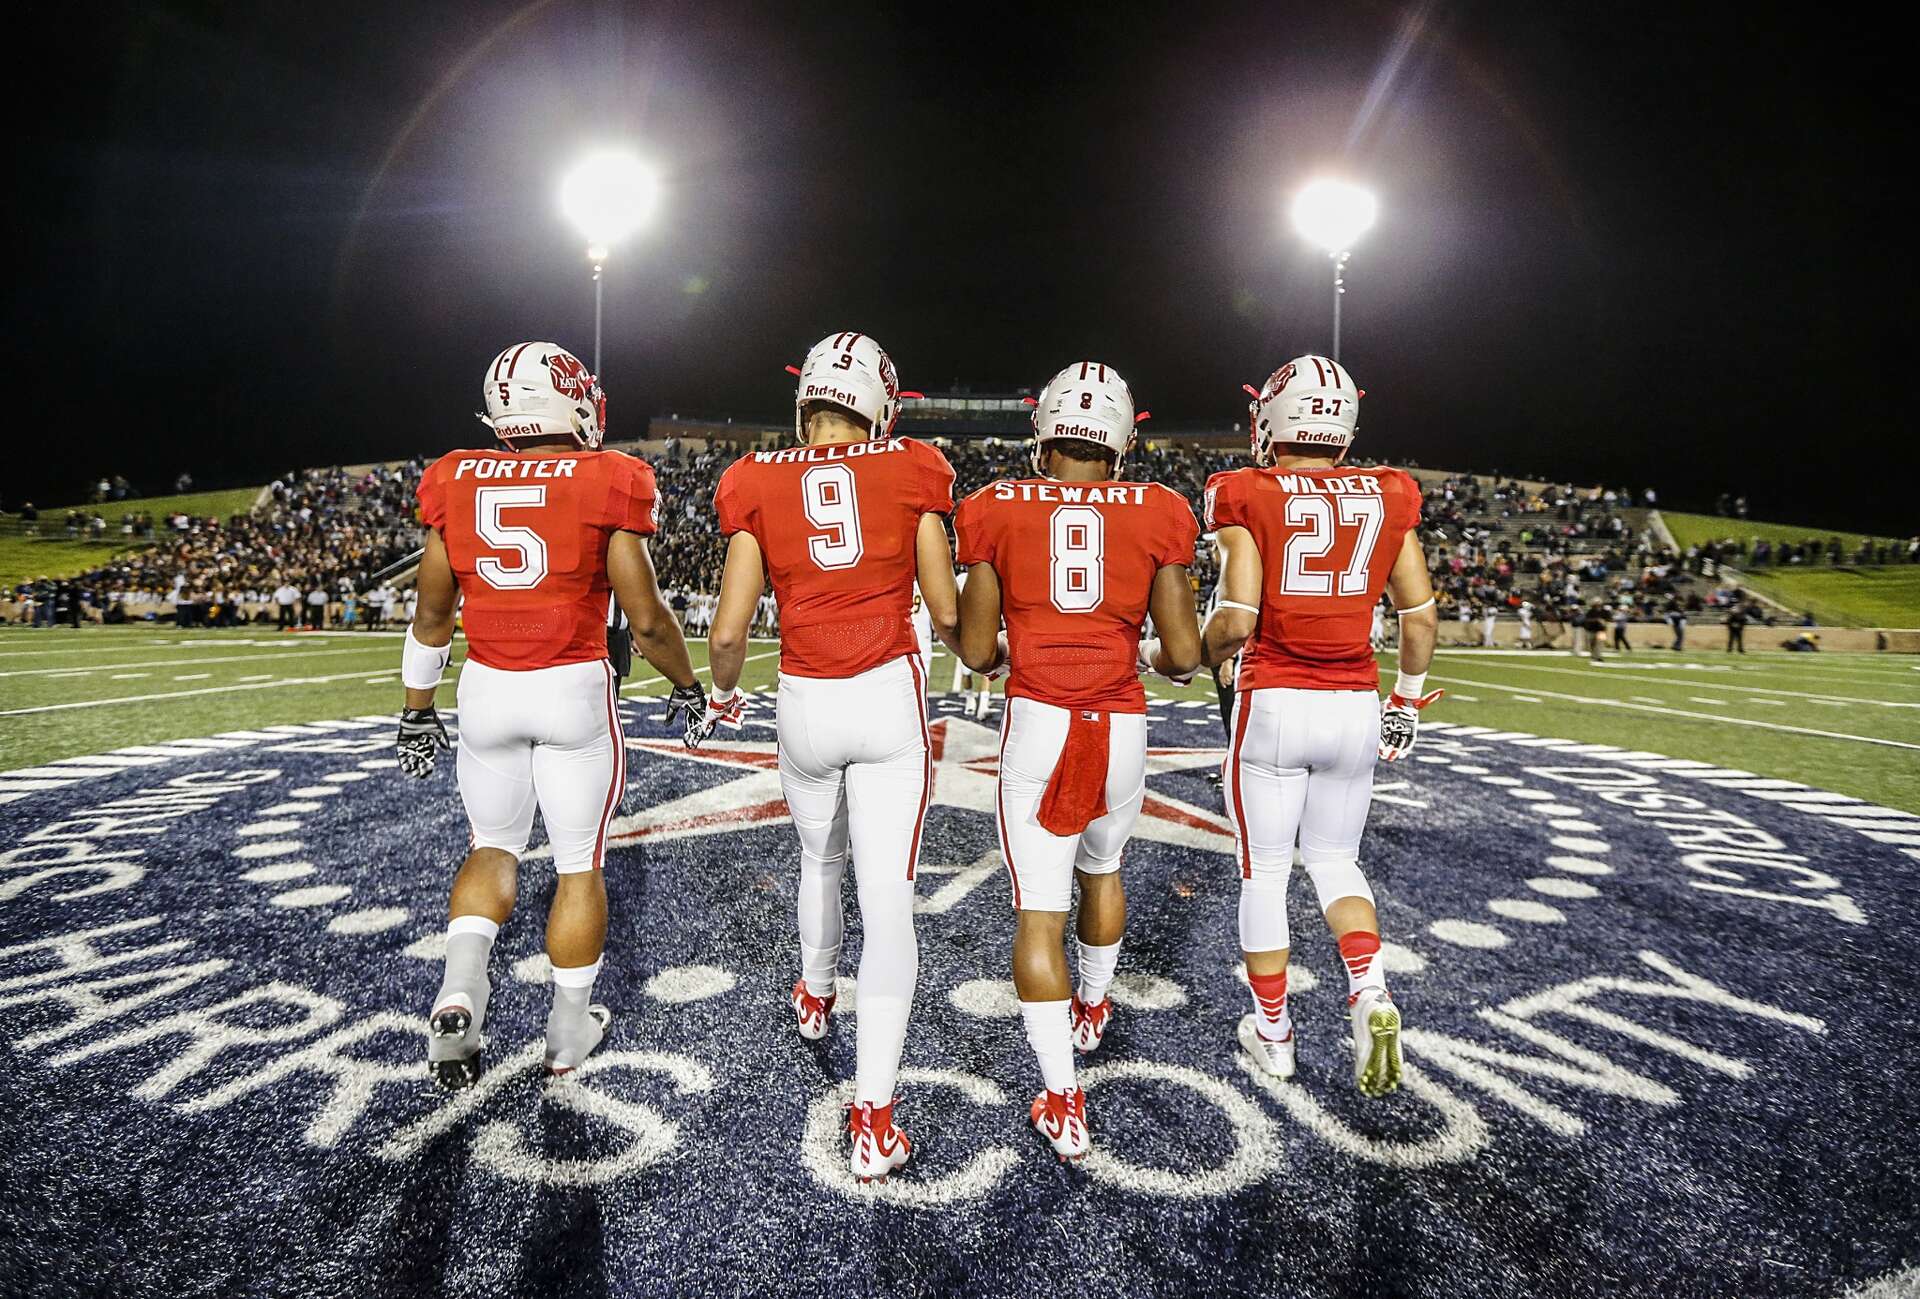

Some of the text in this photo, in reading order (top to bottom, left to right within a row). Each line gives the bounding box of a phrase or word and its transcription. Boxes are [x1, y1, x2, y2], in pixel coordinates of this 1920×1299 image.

[839, 354, 853, 371] 9
[498, 382, 510, 400] 5
[805, 385, 857, 407] Riddell
[1080, 392, 1093, 410] 8
[496, 422, 543, 438] Riddell
[1054, 422, 1108, 443] Riddell
[1296, 430, 1346, 445] Riddell
[754, 439, 906, 464] WHILLOCK
[454, 458, 578, 481] PORTER
[994, 482, 1149, 505] STEWART
[1275, 474, 1383, 494] WILDER
[800, 462, 864, 572] 9
[475, 485, 549, 591] 5
[1280, 494, 1385, 596] 27
[1050, 504, 1104, 614] 8
[1520, 766, 1870, 925] DISTRICT
[799, 950, 1828, 1206] COUNTY
